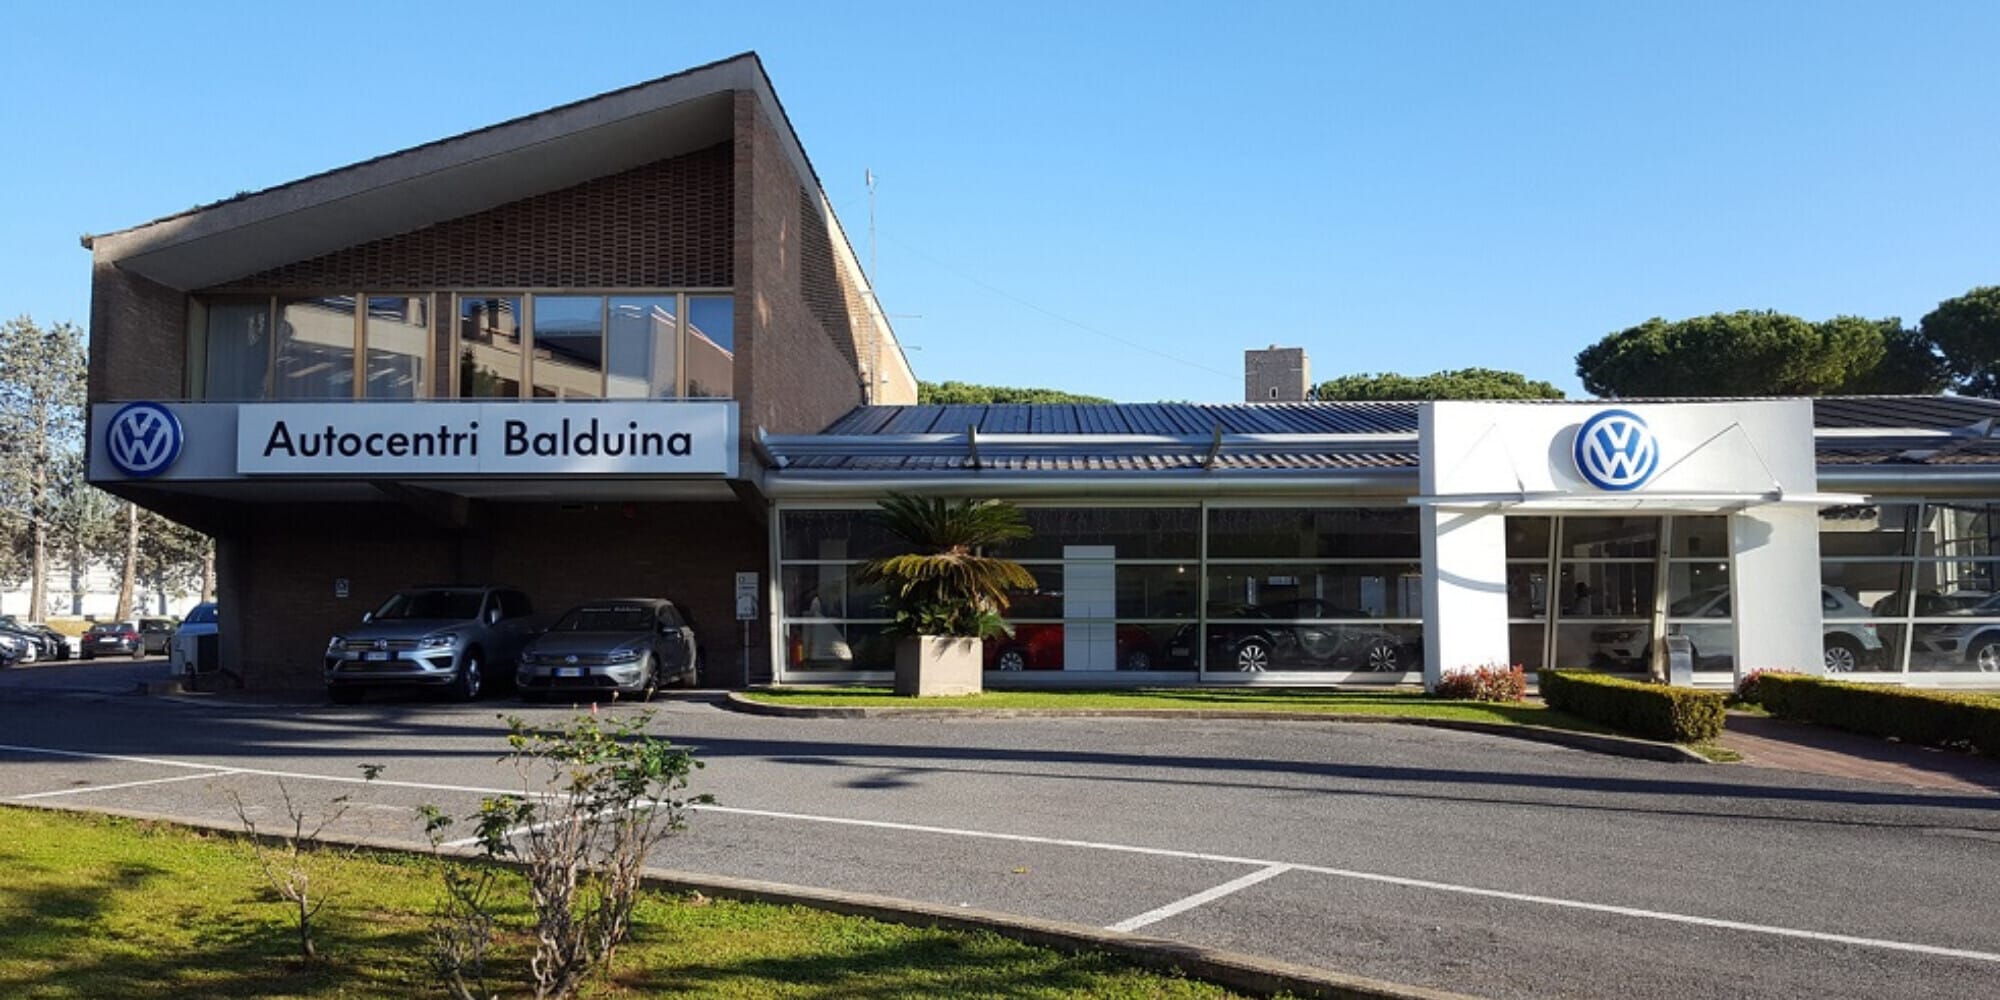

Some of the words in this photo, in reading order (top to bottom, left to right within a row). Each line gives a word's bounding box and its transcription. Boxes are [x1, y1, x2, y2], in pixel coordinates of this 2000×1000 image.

[112, 408, 173, 470] VW
[263, 420, 479, 457] Autocentri
[504, 418, 691, 457] Balduina
[1585, 416, 1653, 484] VW
